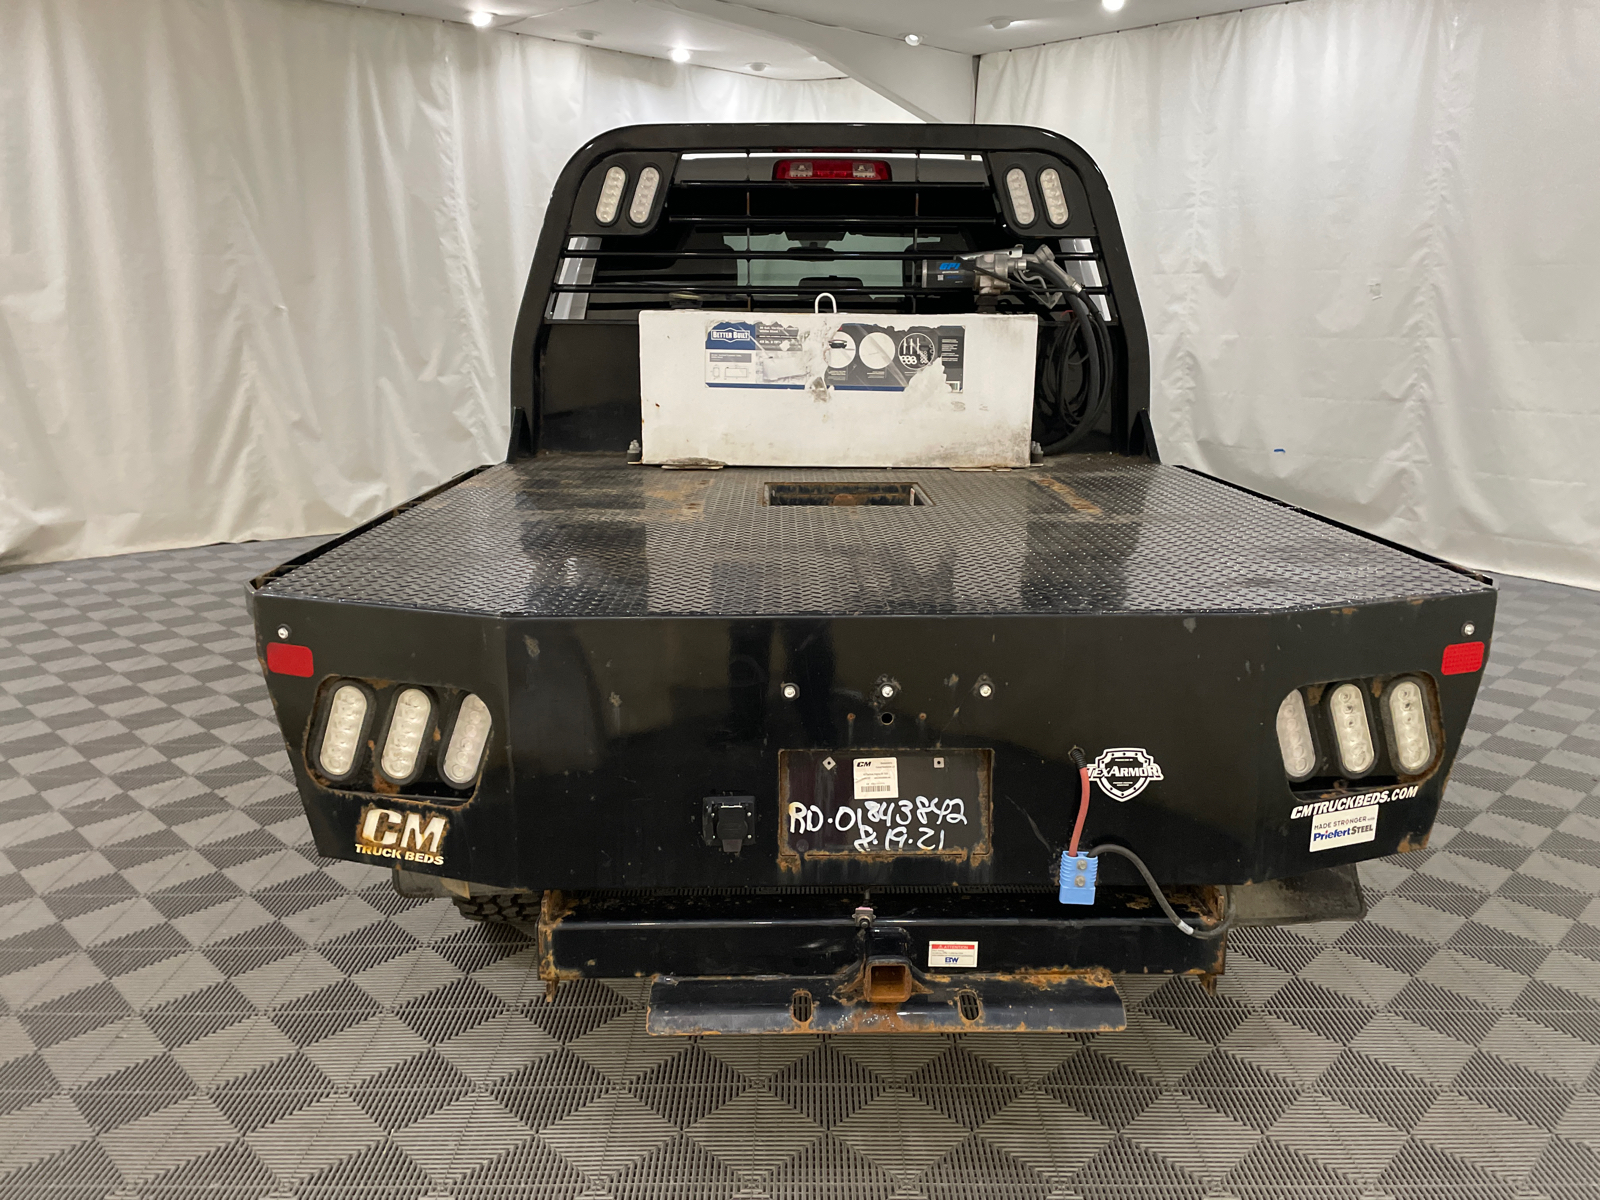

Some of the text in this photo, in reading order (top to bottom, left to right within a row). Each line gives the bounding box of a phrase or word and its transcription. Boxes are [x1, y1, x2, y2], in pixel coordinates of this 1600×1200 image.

[939, 262, 961, 270] GPI
[712, 331, 748, 339] BETTER BUILT
[1290, 786, 1419, 819] CMTRUCKBEDS.COM
[362, 808, 446, 853] CM
[1314, 816, 1367, 830] MADE STRONGER
[355, 843, 445, 865] TRUCK BEDS
